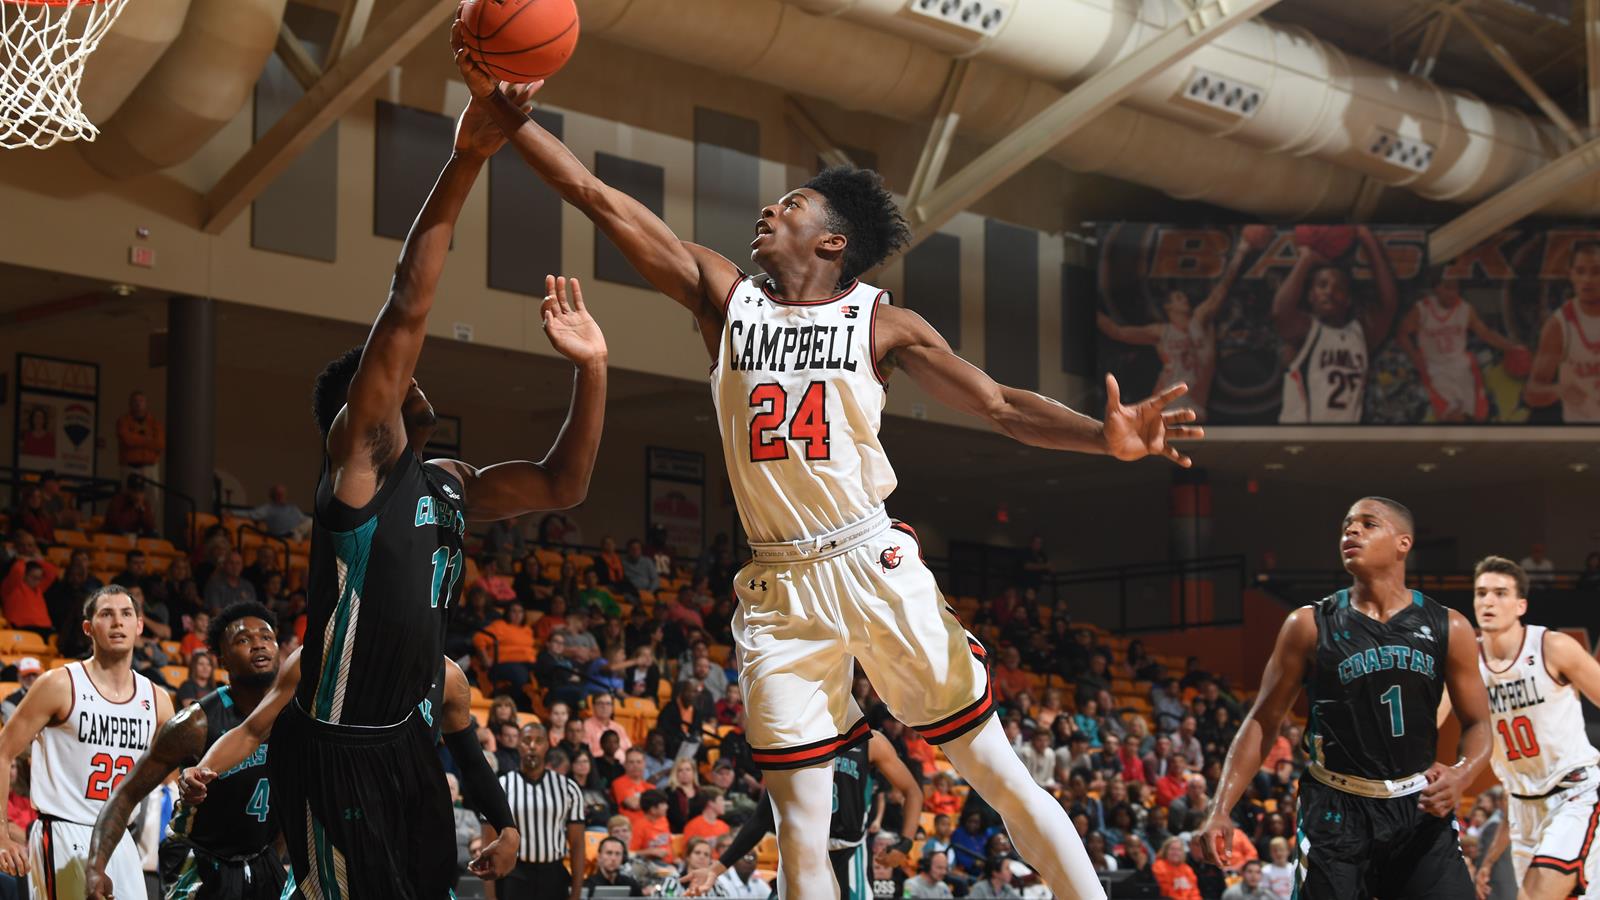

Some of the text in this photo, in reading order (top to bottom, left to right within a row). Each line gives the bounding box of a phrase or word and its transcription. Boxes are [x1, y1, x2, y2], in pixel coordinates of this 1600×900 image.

[730, 320, 858, 372] CAMPBELL
[750, 381, 831, 462] 24
[431, 545, 463, 608] 11
[1338, 645, 1437, 686] COASTAL
[1380, 684, 1405, 737] 1
[1487, 676, 1545, 714] MPBELL
[78, 711, 150, 752] CAMPBELL
[1497, 715, 1541, 761] 10
[246, 777, 270, 823] 4
